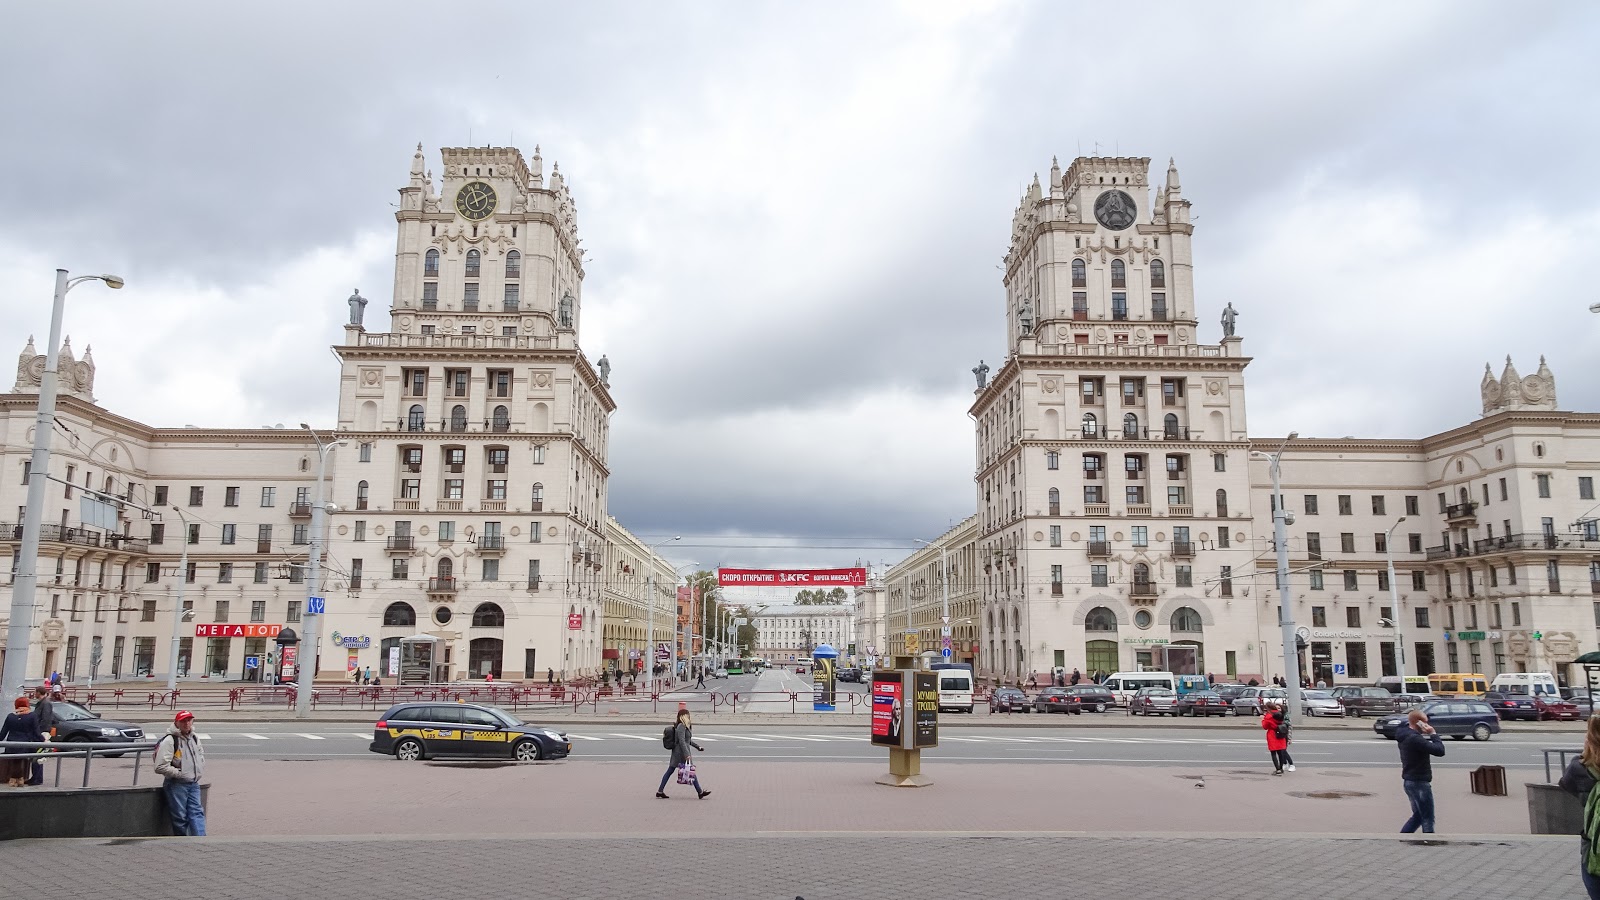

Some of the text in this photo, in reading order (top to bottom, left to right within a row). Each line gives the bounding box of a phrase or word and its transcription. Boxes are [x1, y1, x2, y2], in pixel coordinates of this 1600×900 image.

[722, 573, 741, 582] СКОРО
[786, 573, 810, 582] KFC
[197, 625, 280, 635] МЕГАТОП
[1313, 631, 1338, 639] Golden
[1339, 631, 1362, 639] Coffee
[917, 689, 937, 700] МУМИЙ
[917, 701, 937, 711] ТРОЛЛЬ
